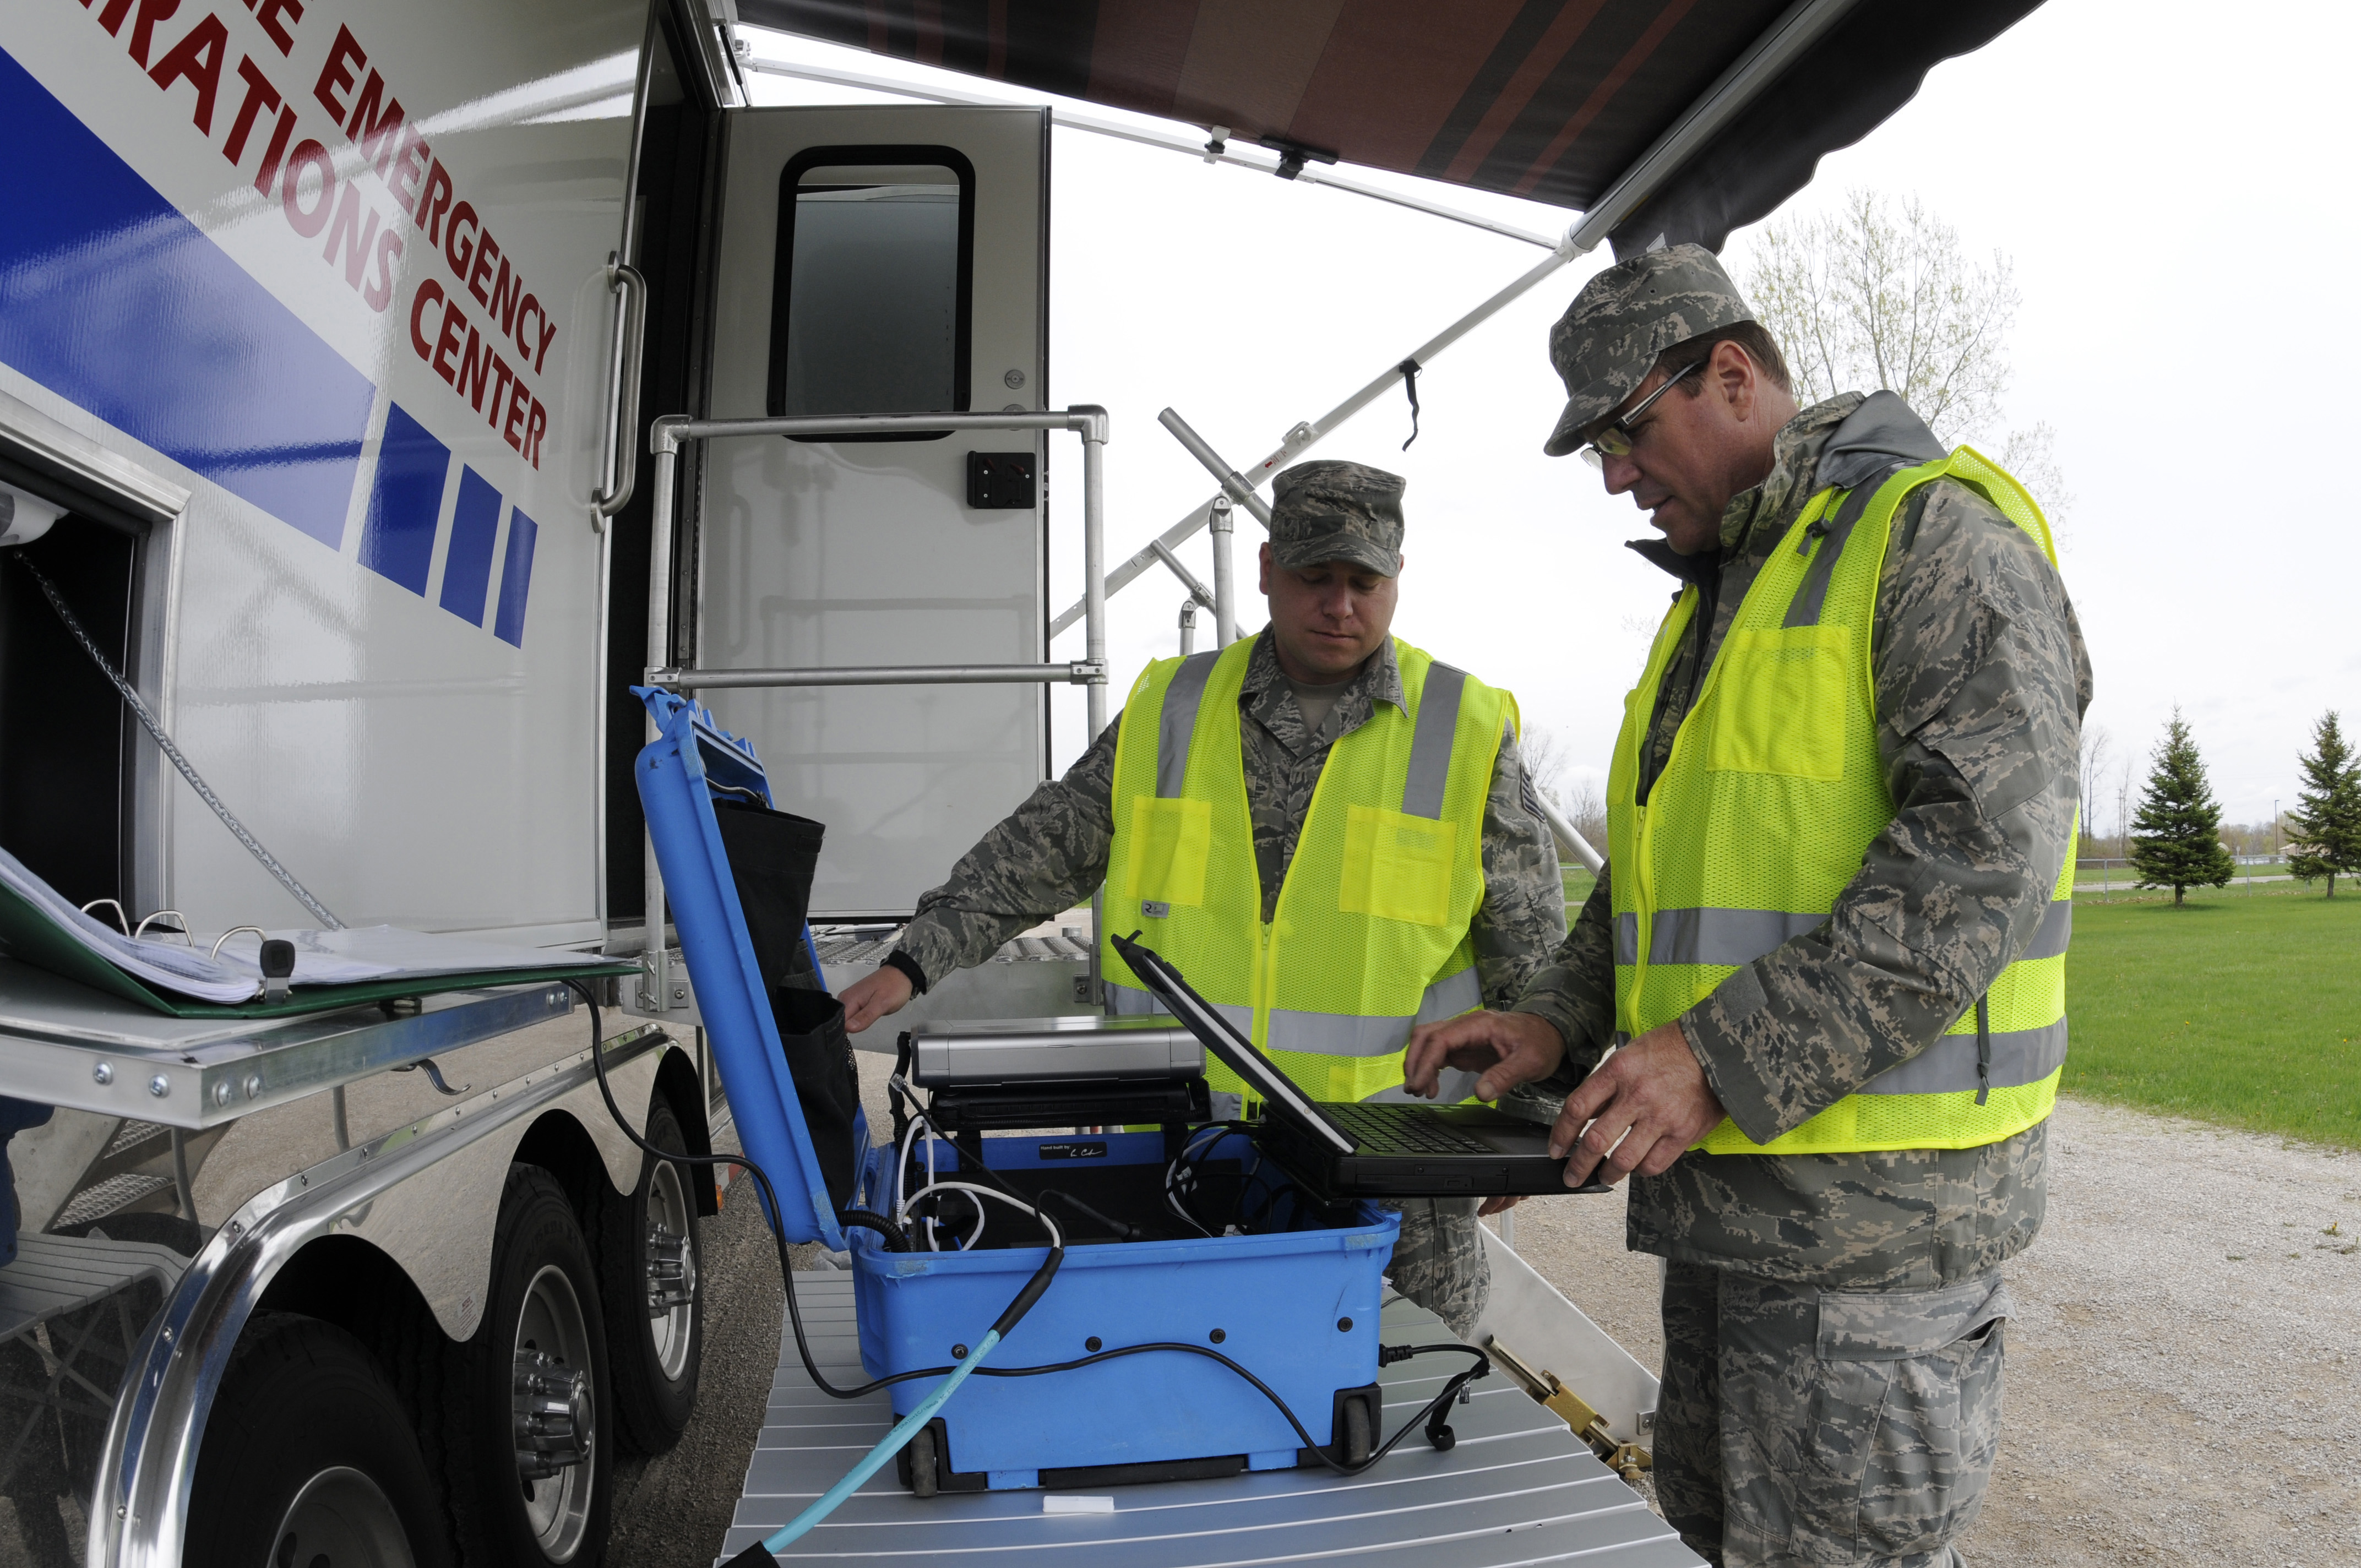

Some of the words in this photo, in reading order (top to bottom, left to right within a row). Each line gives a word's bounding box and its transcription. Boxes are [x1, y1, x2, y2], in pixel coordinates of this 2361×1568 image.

[78, 0, 404, 313] RATIONS
[410, 278, 547, 471] CENTER
[313, 22, 557, 376] EMERGENCY
